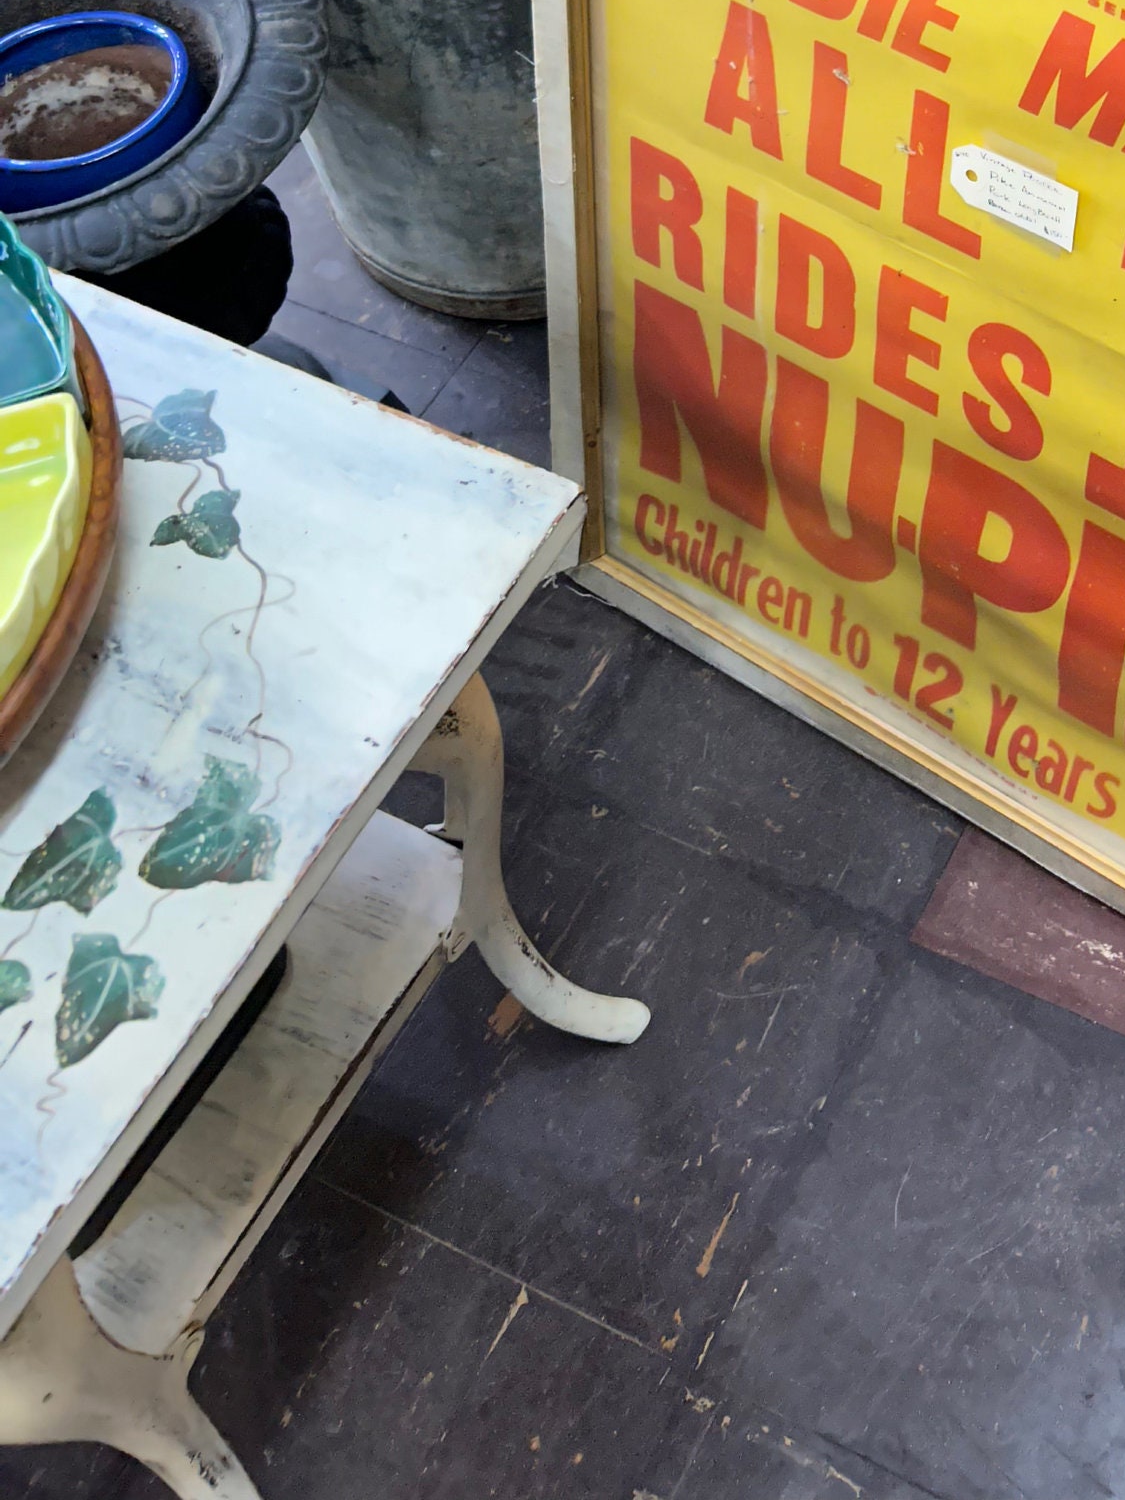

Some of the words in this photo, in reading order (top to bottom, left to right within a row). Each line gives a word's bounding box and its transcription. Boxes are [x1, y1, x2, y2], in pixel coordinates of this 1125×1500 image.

[704, 0, 982, 260] ALL
[629, 136, 1051, 462] RIDES
[634, 494, 813, 638] Children
[830, 597, 871, 669] to
[893, 636, 964, 730] 12
[984, 683, 1116, 819] Years
